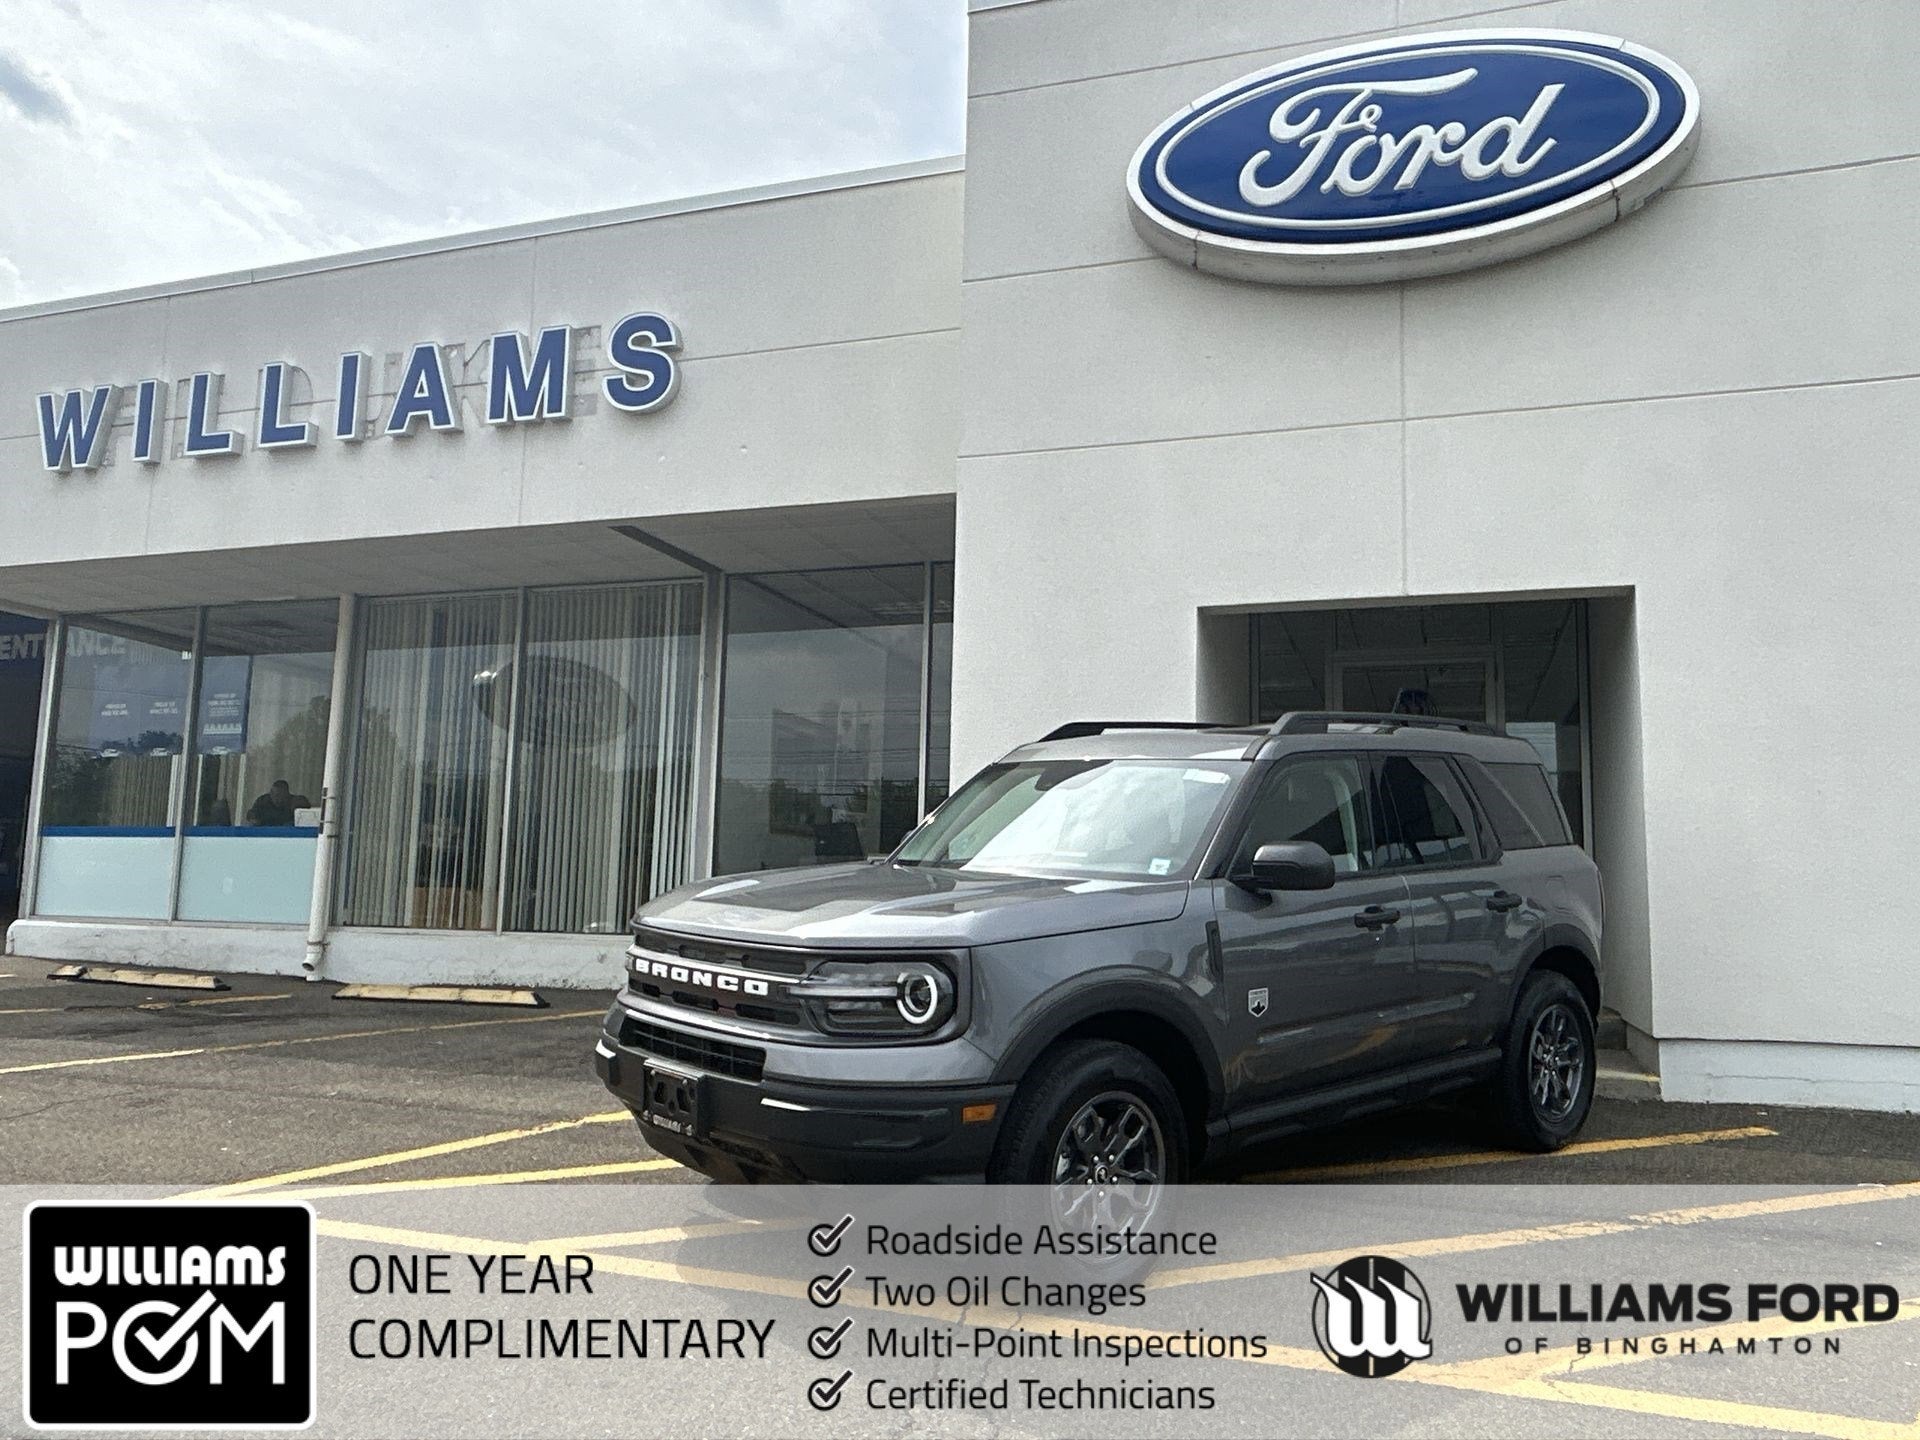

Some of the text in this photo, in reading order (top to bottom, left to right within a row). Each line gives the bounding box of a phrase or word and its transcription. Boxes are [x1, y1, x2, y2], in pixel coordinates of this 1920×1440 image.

[1239, 67, 1566, 207] Ford
[36, 312, 683, 474] WILLIAMS
[0, 630, 127, 660] ENTANCE
[634, 958, 769, 996] BRONCO
